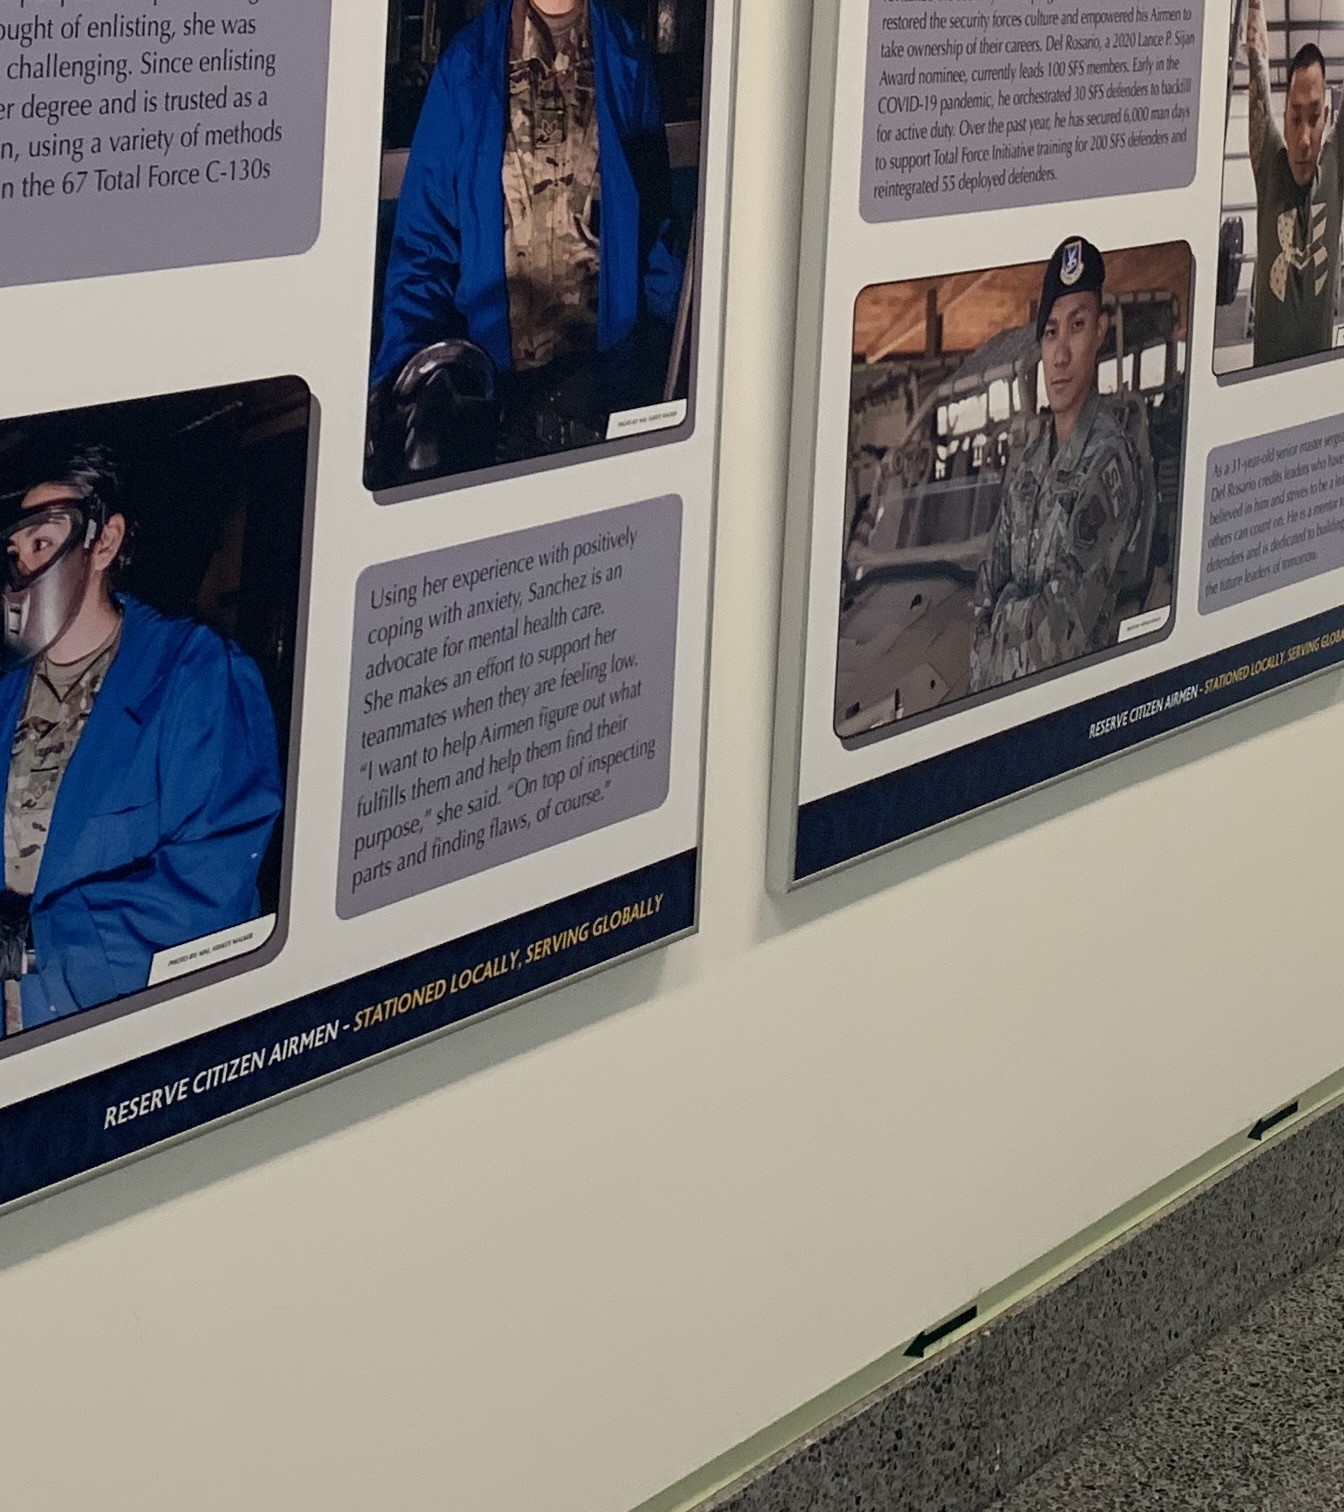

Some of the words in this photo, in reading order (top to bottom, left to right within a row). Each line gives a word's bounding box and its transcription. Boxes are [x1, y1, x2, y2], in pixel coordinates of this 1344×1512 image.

[878, 67, 916, 86] Award
[918, 66, 968, 85] nominee,
[971, 62, 1017, 83] currently
[1019, 61, 1045, 79] leads
[1048, 61, 1066, 78] 100
[1067, 59, 1085, 77] SFS
[1086, 57, 1130, 75] members.
[1132, 55, 1154, 76] Early
[1166, 55, 1180, 71] the
[28, 133, 84, 163] using
[90, 136, 102, 154] a
[109, 127, 175, 156] variety
[180, 122, 201, 148] of
[205, 119, 282, 146] methods
[873, 175, 940, 202] reintegrated
[941, 174, 956, 193] 55
[958, 168, 1006, 194] deployed
[1007, 165, 1057, 185] defenders.
[367, 616, 423, 647] coping
[428, 601, 462, 628] with
[466, 591, 523, 619] anxiety,
[528, 573, 587, 603] Sanchez
[591, 566, 602, 586] is
[605, 564, 623, 582] an
[104, 1077, 190, 1129] RESERVE
[192, 1048, 266, 1094] CITIZEN
[268, 1019, 340, 1065] AIRMEN
[353, 979, 447, 1032] STATIONED
[450, 949, 522, 994] LOCALLY,
[525, 922, 590, 964] SERVING
[592, 893, 664, 937] GLOBALLY
